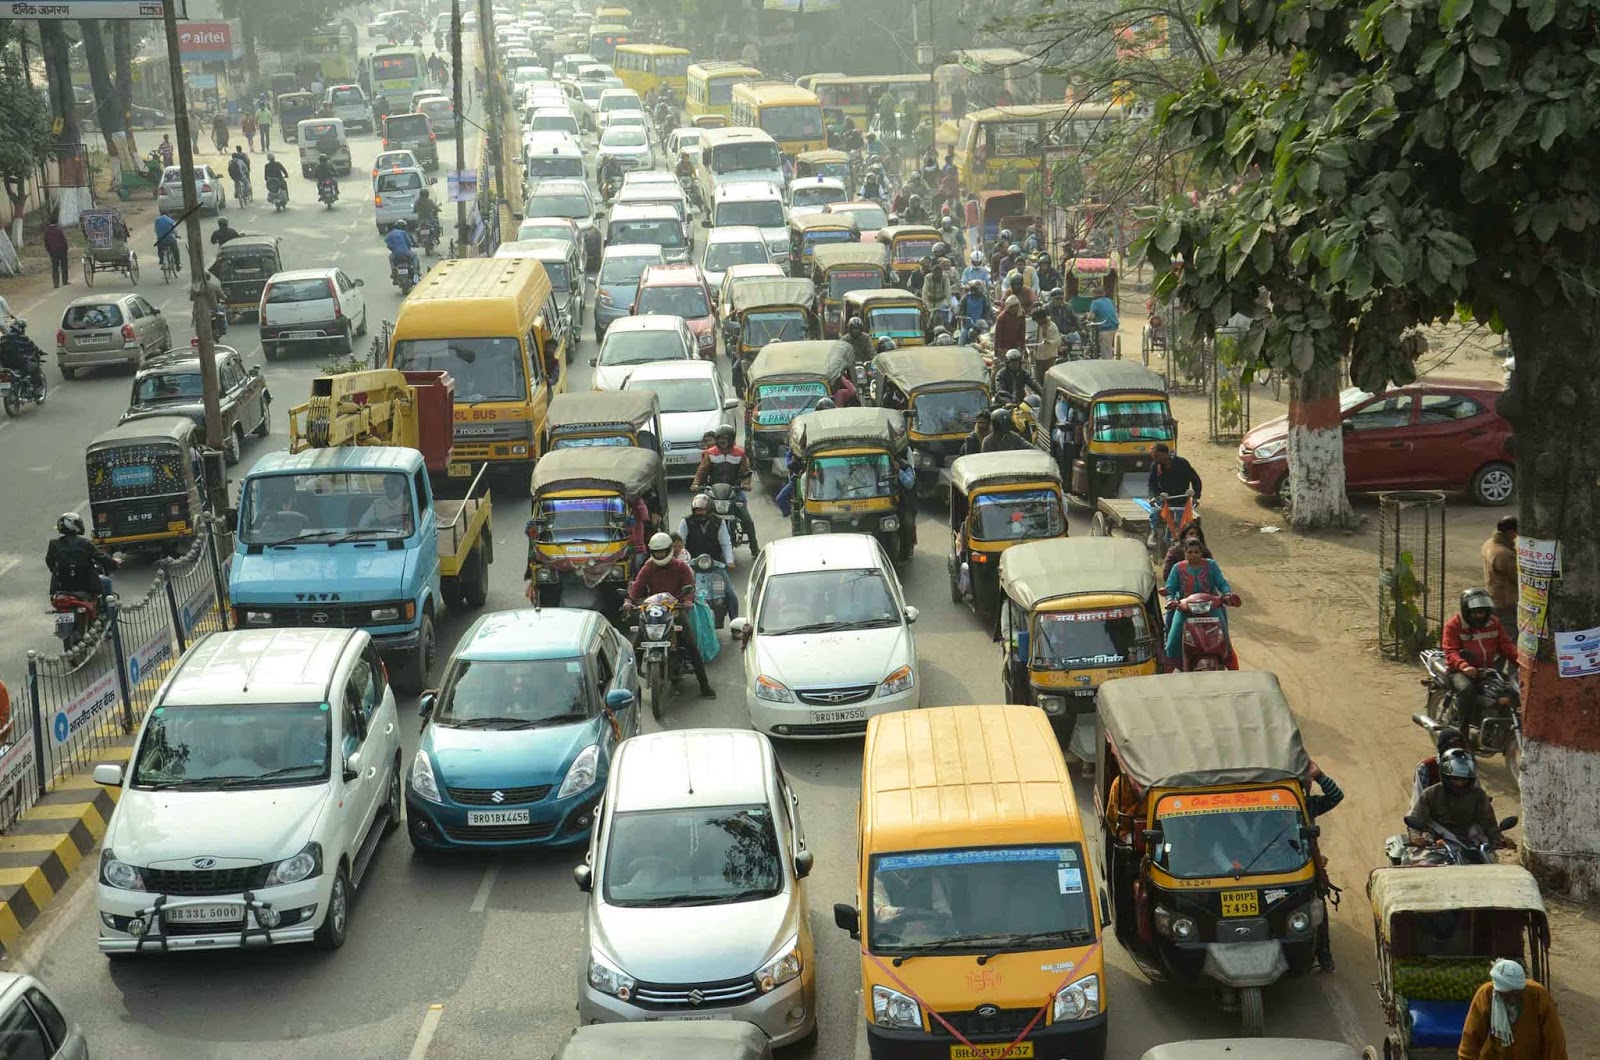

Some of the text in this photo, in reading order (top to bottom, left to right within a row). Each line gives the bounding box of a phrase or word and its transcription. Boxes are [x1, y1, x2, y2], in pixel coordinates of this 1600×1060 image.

[12, 3, 37, 15] दैनिक
[193, 32, 226, 43] airtel
[473, 410, 497, 419] BUS
[296, 592, 340, 601] TATA
[70, 708, 91, 732] भारतीय
[91, 699, 103, 716] स्टेट
[103, 689, 115, 706] बैंक
[815, 709, 865, 722] BR01BN7550
[473, 812, 529, 824] BR01BX4456
[171, 907, 237, 919] BR 33L 5000
[1223, 903, 1258, 914] 7498
